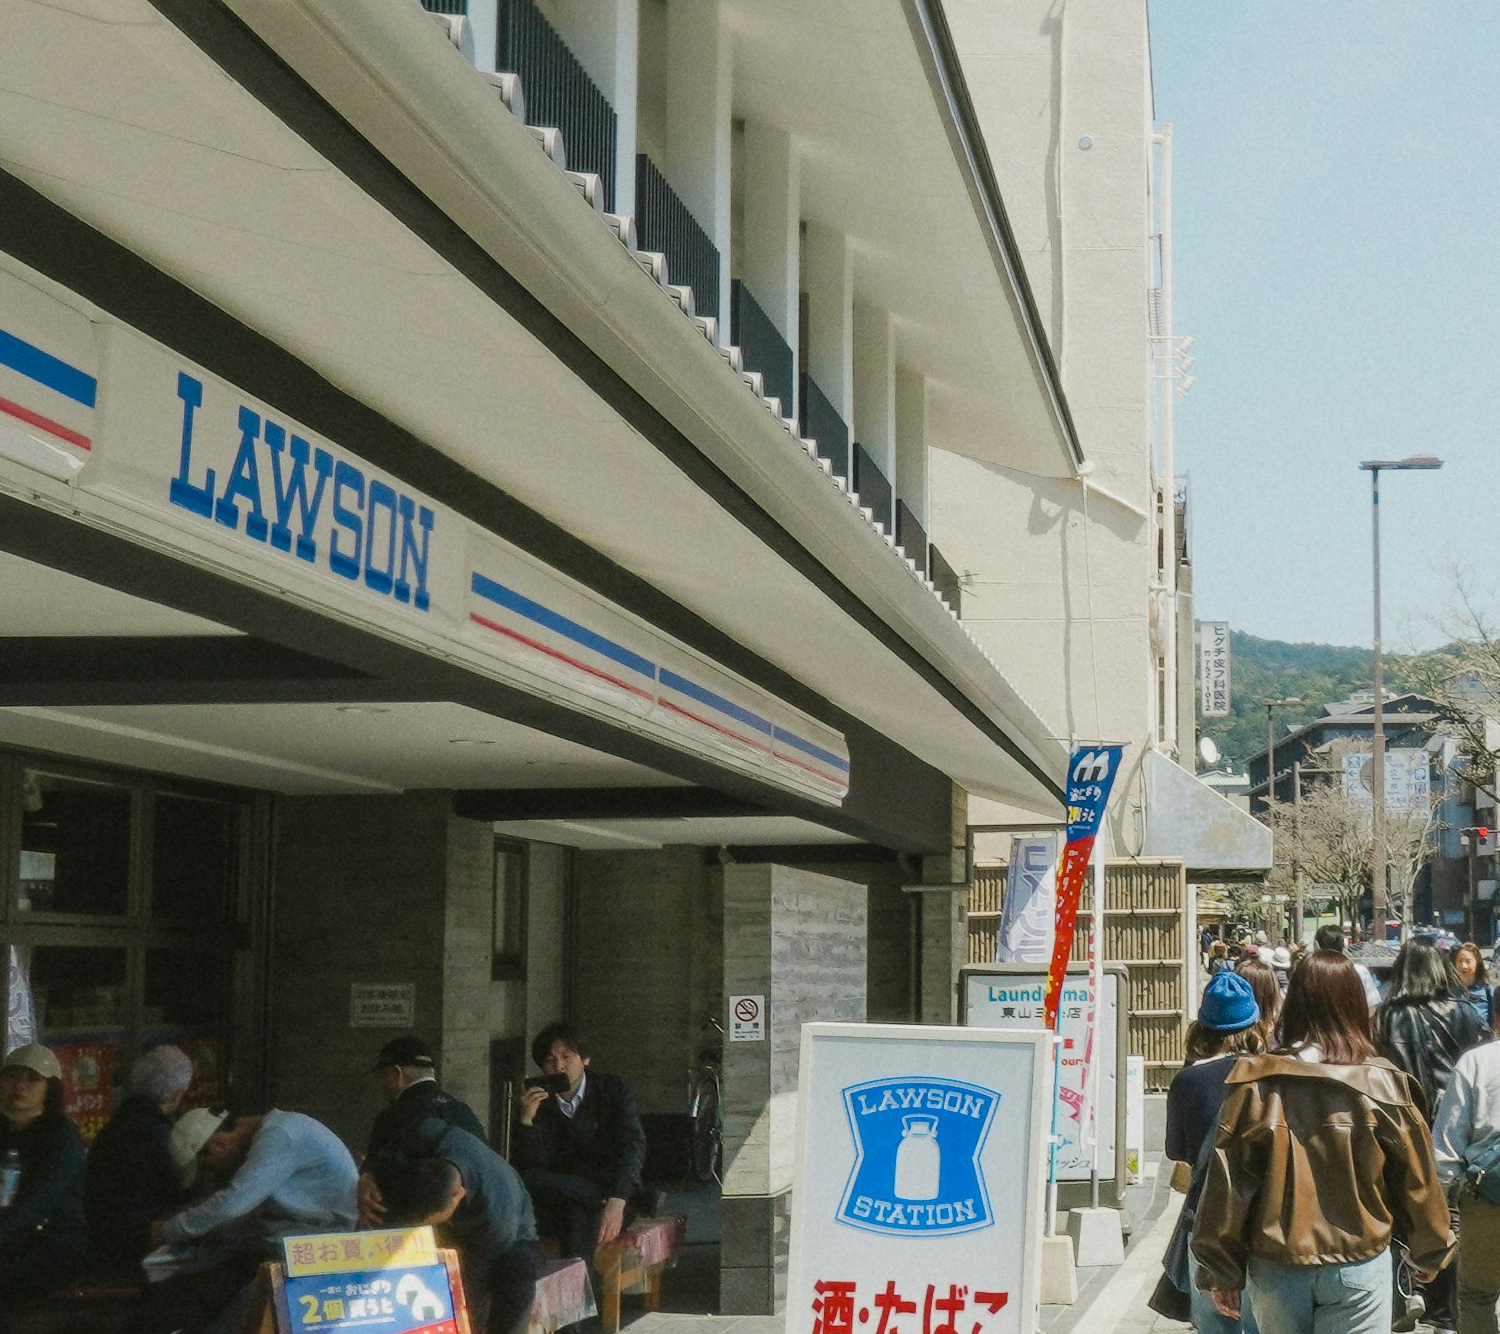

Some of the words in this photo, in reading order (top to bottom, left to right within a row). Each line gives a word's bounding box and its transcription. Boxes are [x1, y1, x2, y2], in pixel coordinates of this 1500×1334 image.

[170, 371, 435, 612] LAWSON
[858, 1087, 986, 1119] LAWSON
[852, 1196, 977, 1227] STATION
